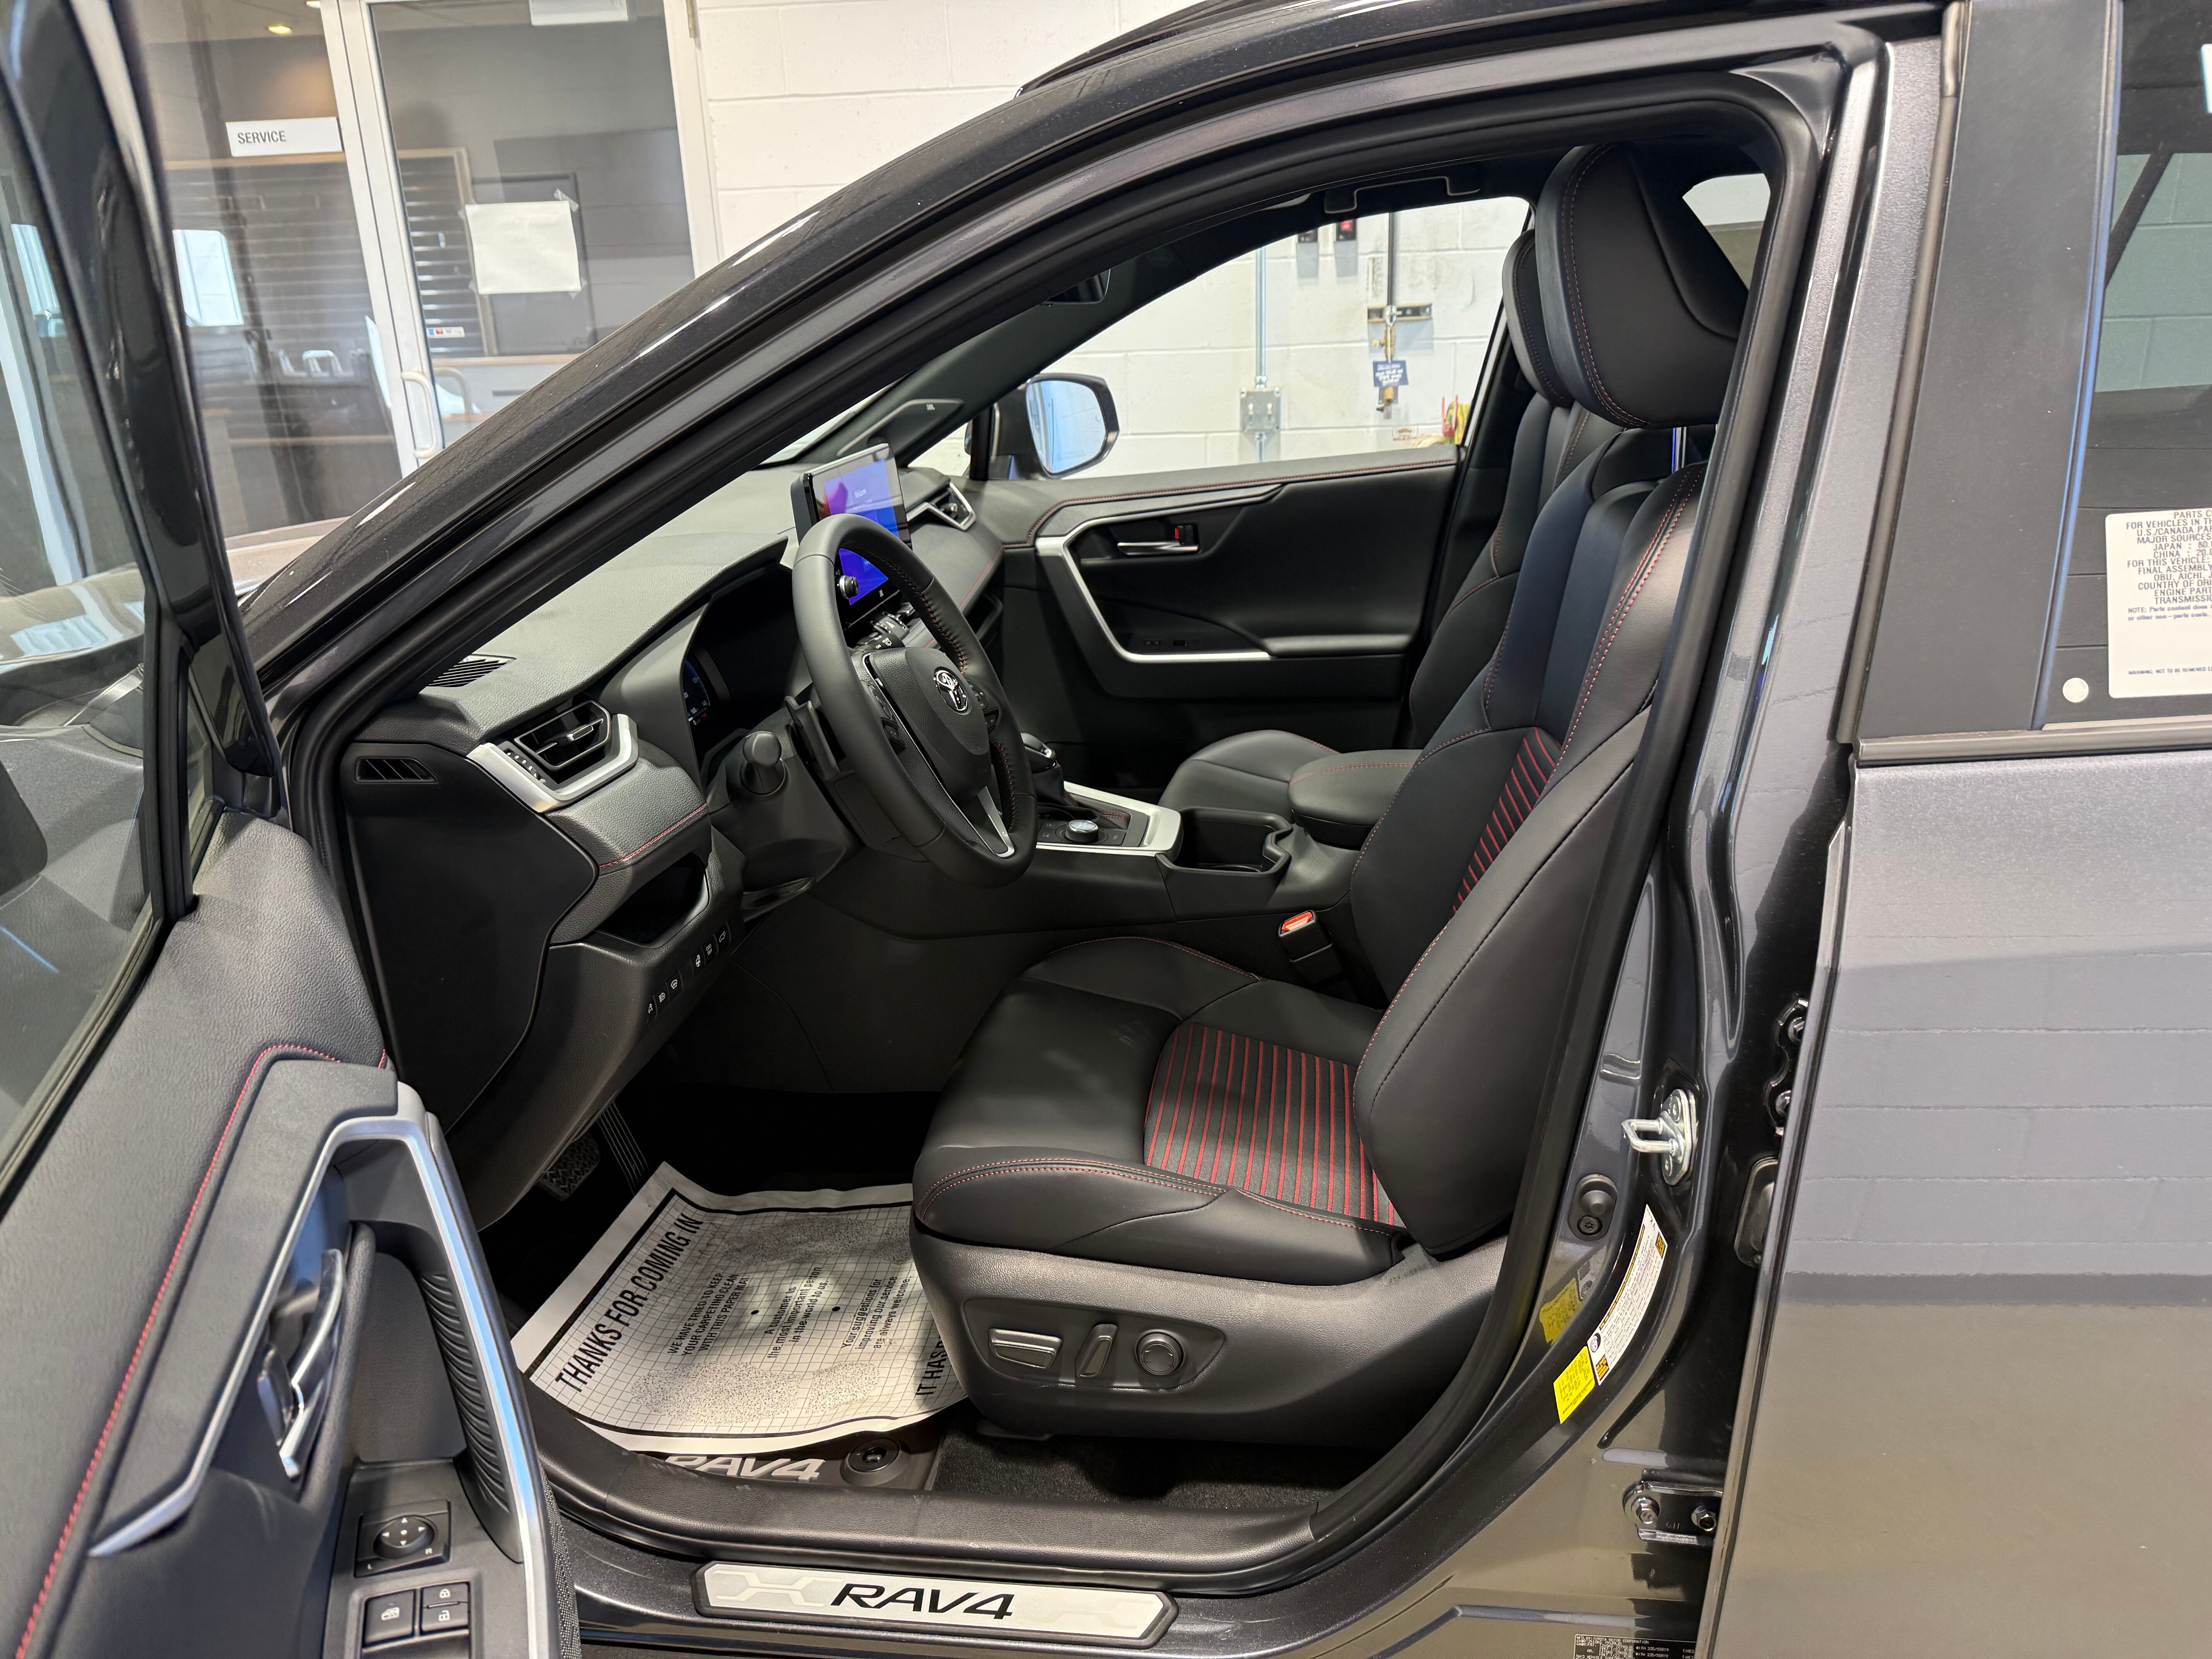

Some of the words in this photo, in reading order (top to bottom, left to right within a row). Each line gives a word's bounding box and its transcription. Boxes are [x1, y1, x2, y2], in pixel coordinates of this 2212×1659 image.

[237, 131, 287, 144] SERVICE
[2146, 519, 2188, 528] VEHICLES
[2174, 510, 2203, 519] PARTS
[2136, 526, 2194, 536] U.S./CANADA
[2137, 536, 2168, 544] MAJOR
[2171, 533, 2212, 542] SOURCES
[2153, 543, 2182, 551] JAPAN
[2153, 550, 2181, 558] CHINA
[2127, 560, 2144, 568] FOR
[2147, 558, 2167, 566] THIS
[2138, 566, 2164, 575] FINAL
[2138, 581, 2180, 590] COUNTRY
[2154, 588, 2187, 596] ENGINE
[555, 1323, 622, 1393] THANKS
[605, 1290, 647, 1327] FOR
[631, 1231, 691, 1291] COMING
[674, 1213, 704, 1234] IN
[767, 1346, 780, 1358] the
[776, 1325, 791, 1343] most
[784, 1289, 809, 1326] important
[804, 1267, 822, 1287] person
[770, 1296, 791, 1328] customer
[855, 1314, 882, 1349] improving
[875, 1301, 886, 1312] our
[881, 1276, 897, 1300] service
[667, 1341, 682, 1354] WE
[675, 1322, 694, 1340] HAVE
[688, 1301, 707, 1321] TRIED
[701, 1290, 713, 1299] TO
[708, 1273, 724, 1288] KEEP
[682, 1334, 702, 1356] YOUR
[696, 1295, 725, 1333] CARPETING
[719, 1274, 739, 1293] CLEAN
[699, 1333, 717, 1351] WITH
[710, 1315, 727, 1331] THIS
[721, 1291, 741, 1312] PAPER
[735, 1278, 749, 1290] MAT
[794, 1321, 807, 1333] the
[802, 1299, 818, 1320] world
[841, 1332, 857, 1348] Your
[852, 1289, 877, 1330] suggestions
[870, 1279, 882, 1288] for
[874, 1338, 884, 1348] are
[879, 1311, 896, 1336] always
[922, 1352, 948, 1379] HAS
[915, 1383, 937, 1395] IT
[830, 1583, 1014, 1620] RAV4
